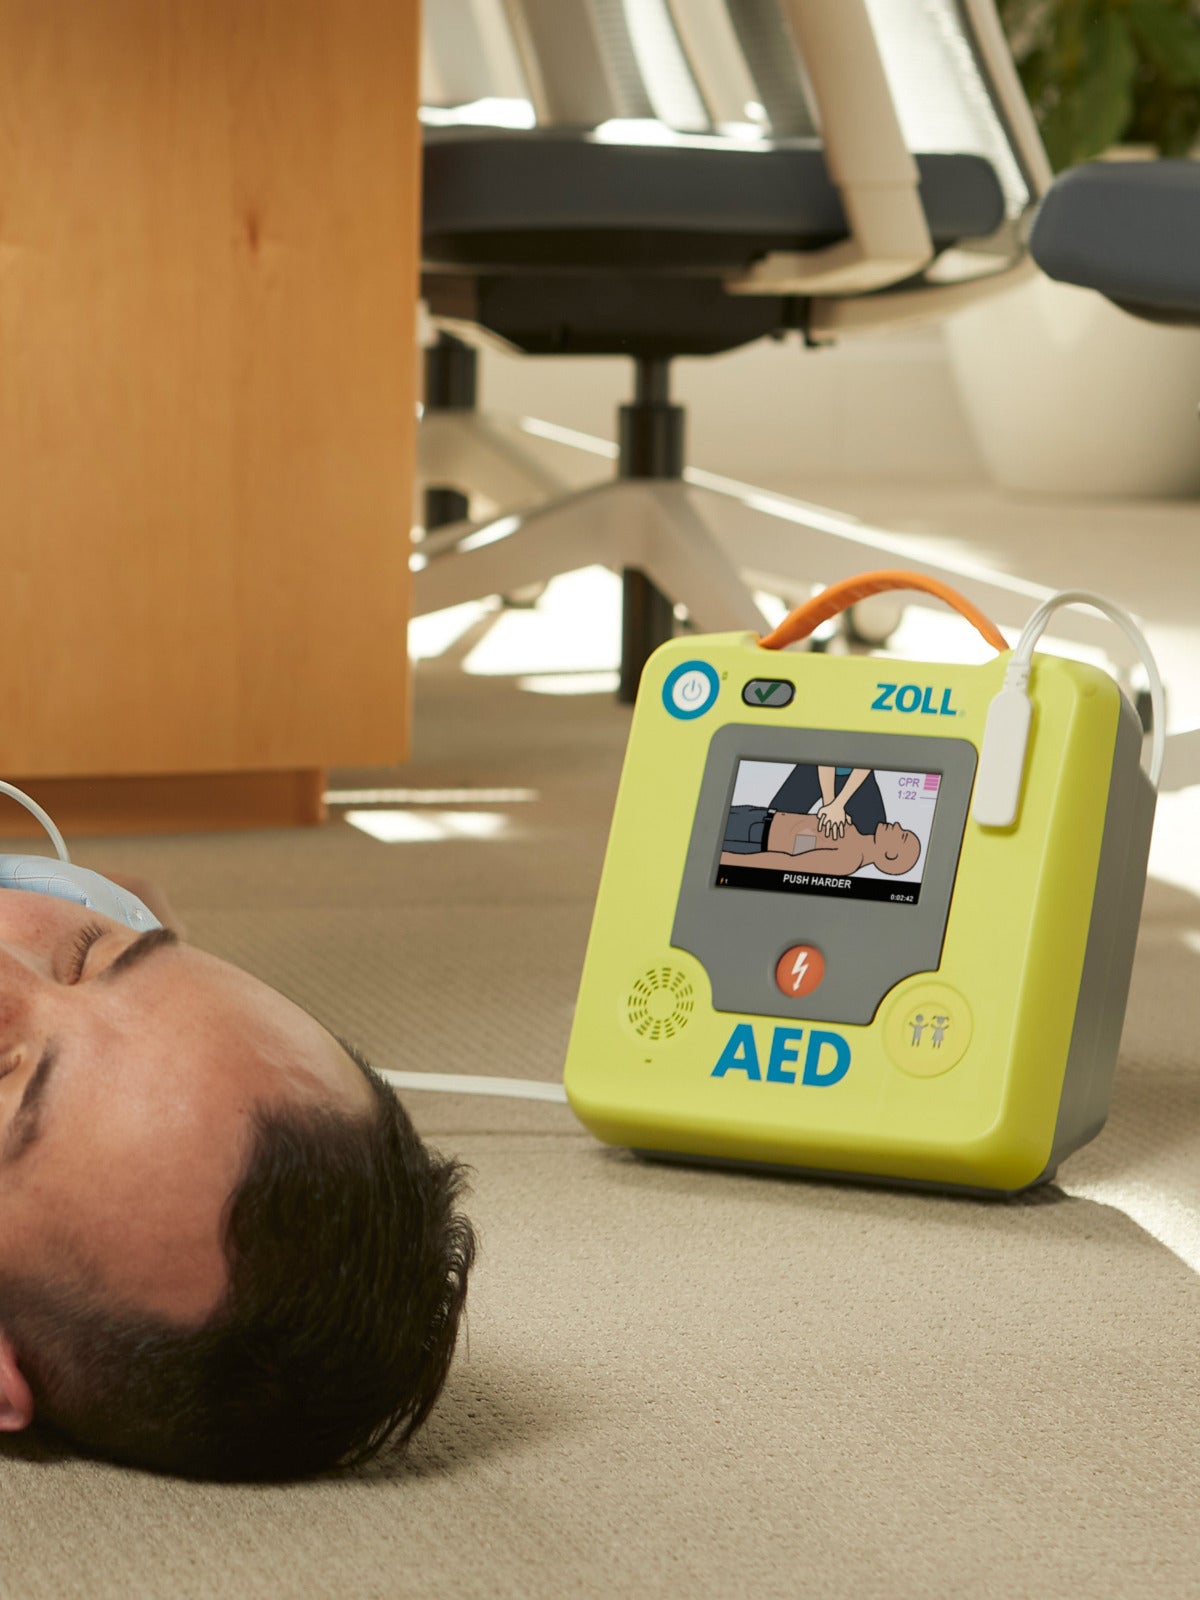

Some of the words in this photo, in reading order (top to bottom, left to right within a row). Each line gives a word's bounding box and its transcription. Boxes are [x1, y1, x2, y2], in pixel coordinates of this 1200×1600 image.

[871, 683, 957, 716] ZOLL
[898, 777, 920, 788] CPR
[897, 790, 917, 801] 1:22
[783, 873, 810, 885] PUSH
[811, 876, 852, 889] HARDER
[890, 893, 914, 903] 0:02:42
[710, 1023, 852, 1087] AED
